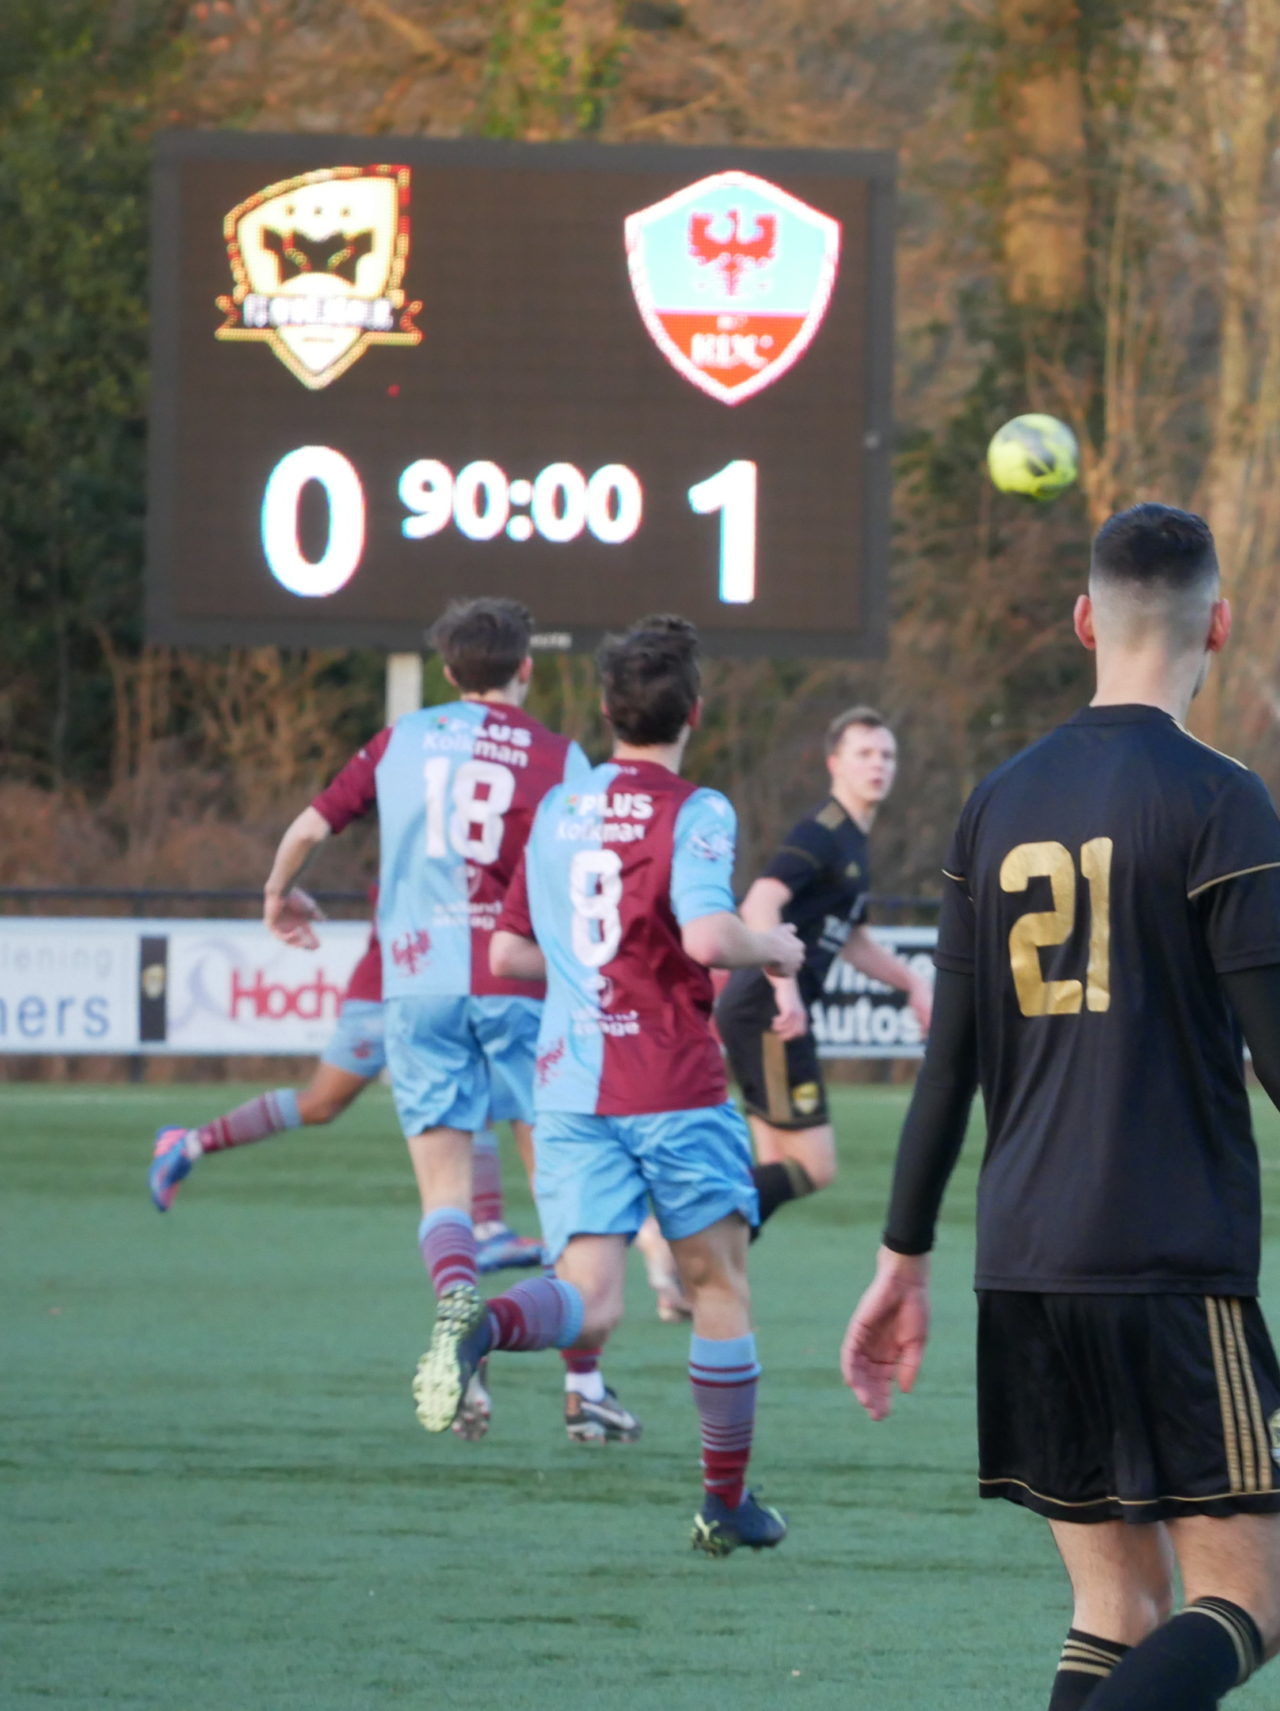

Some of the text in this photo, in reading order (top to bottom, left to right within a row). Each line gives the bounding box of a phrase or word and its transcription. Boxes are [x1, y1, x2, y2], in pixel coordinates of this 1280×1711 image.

[261, 445, 757, 604] 0 90:00 1
[424, 757, 515, 864] 18
[578, 793, 653, 819] PLUS
[569, 849, 622, 967] 8
[1000, 837, 1113, 1018] 21
